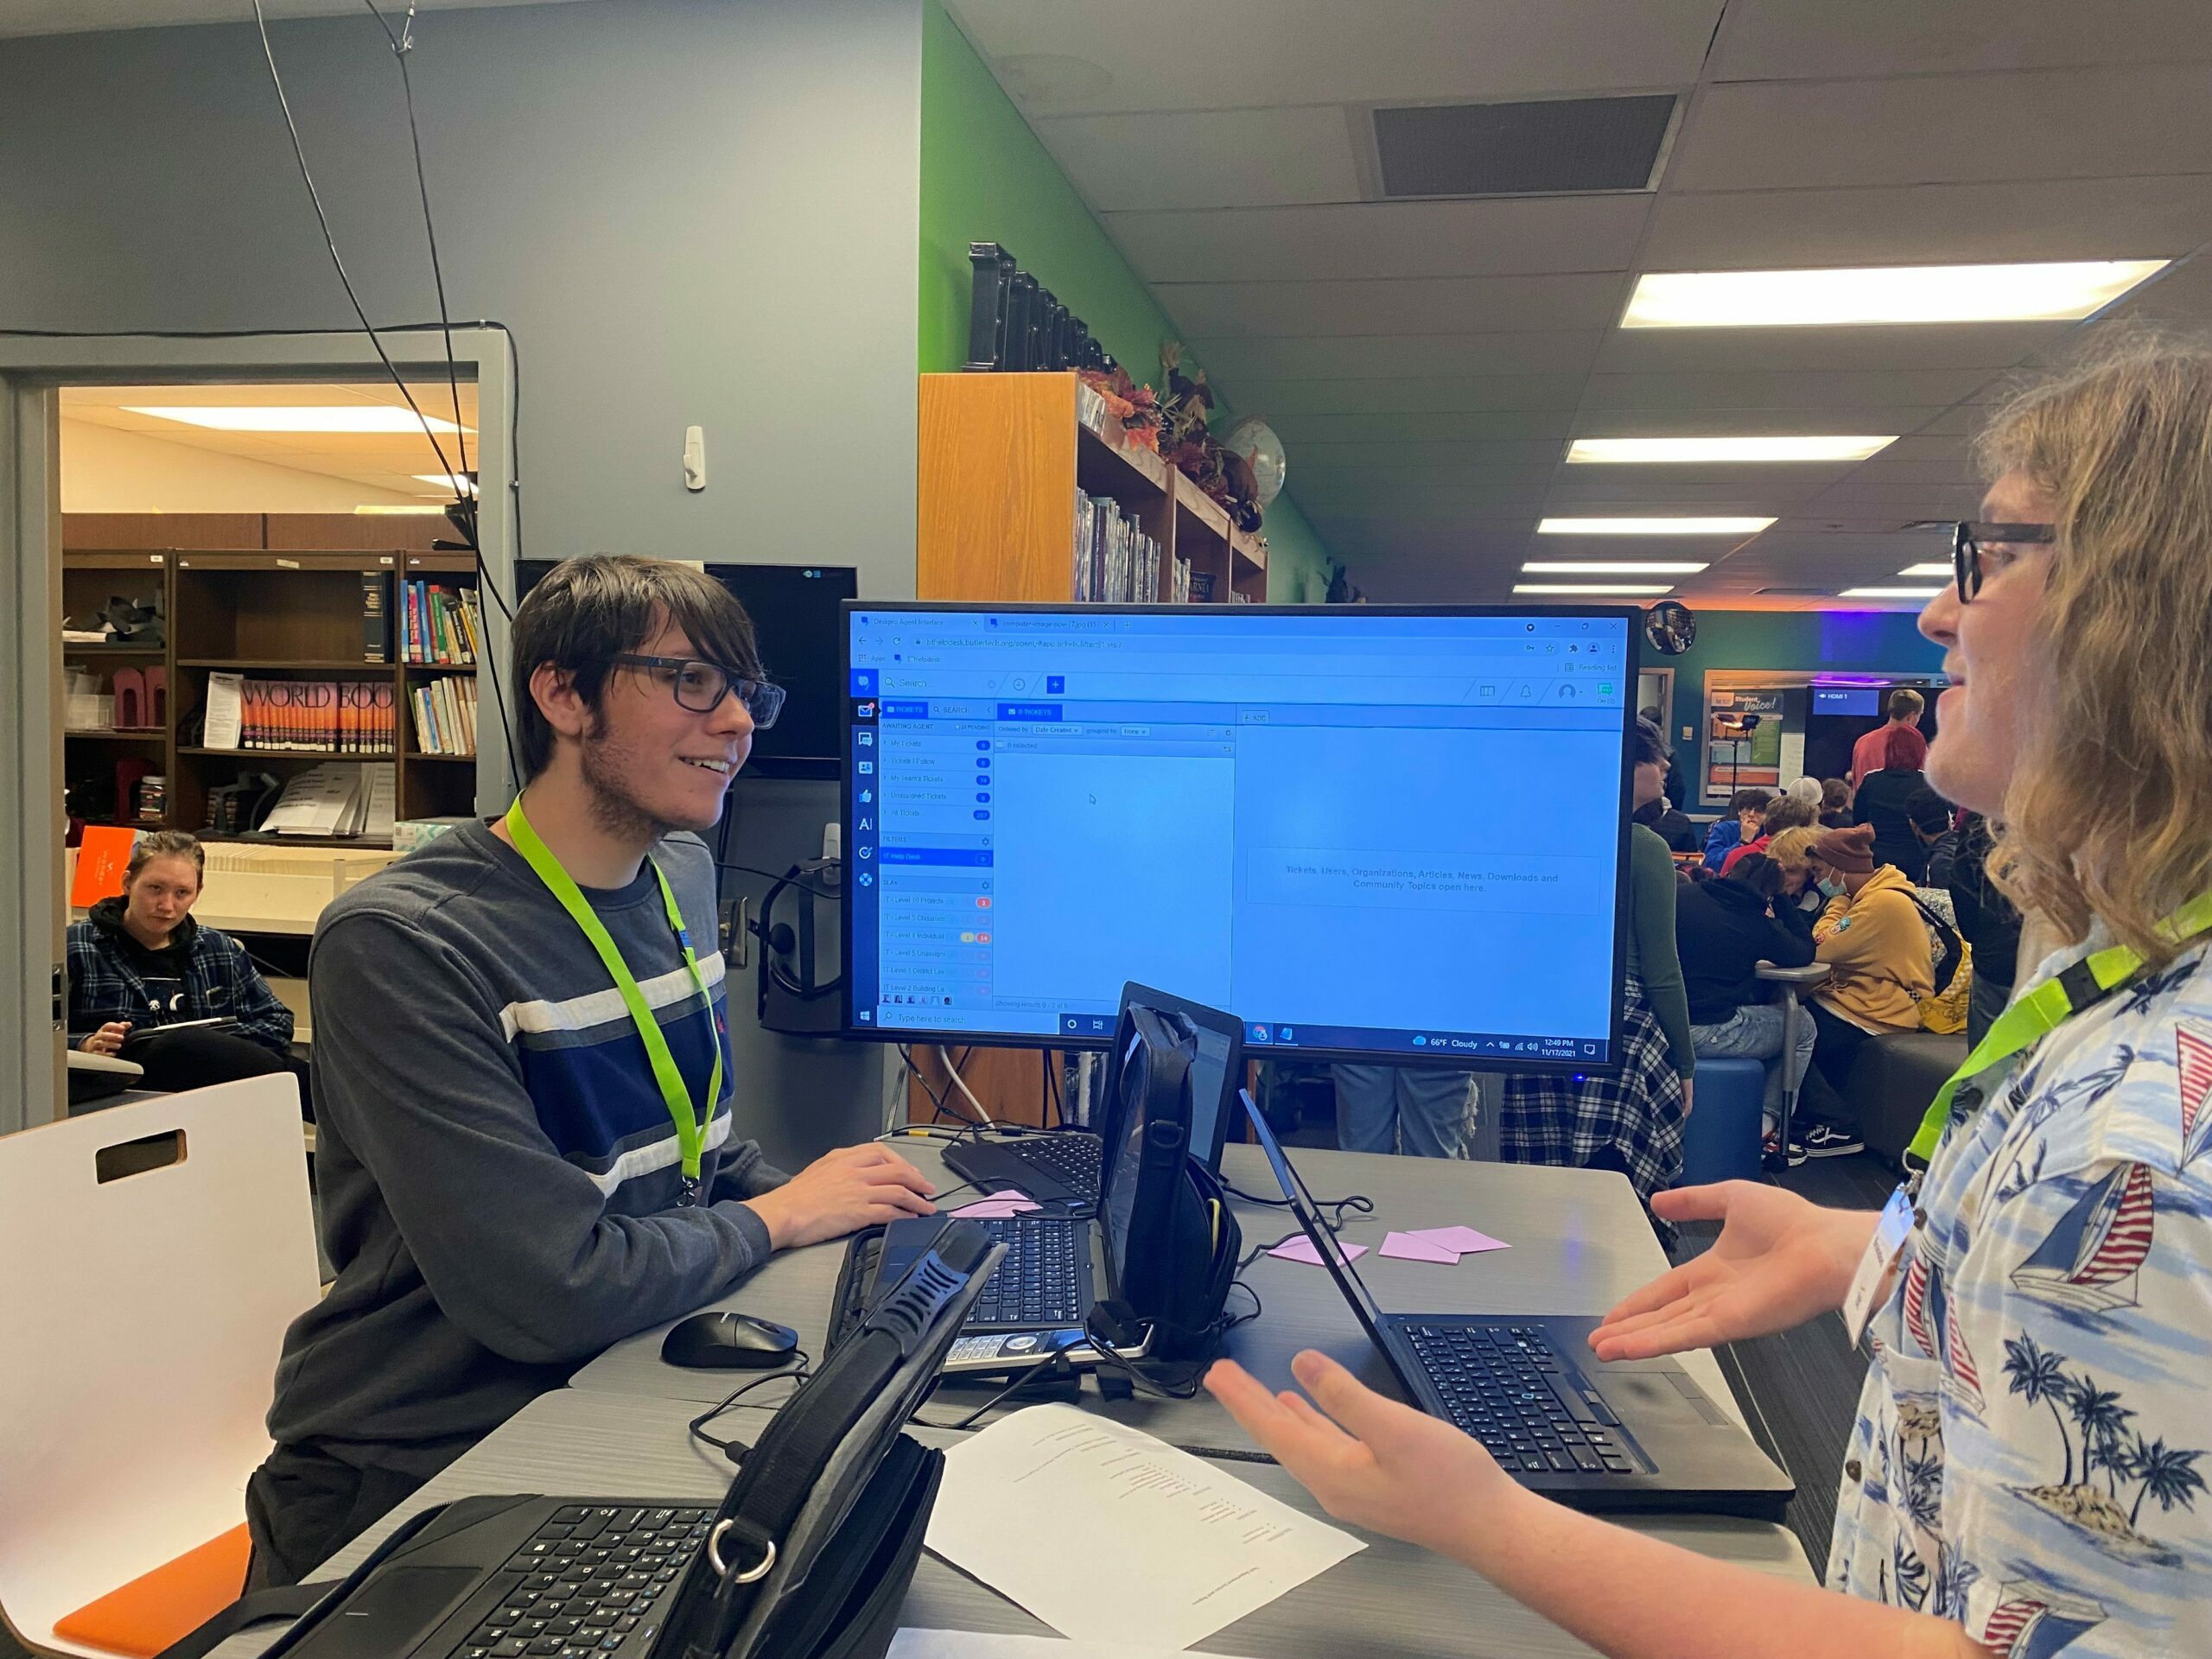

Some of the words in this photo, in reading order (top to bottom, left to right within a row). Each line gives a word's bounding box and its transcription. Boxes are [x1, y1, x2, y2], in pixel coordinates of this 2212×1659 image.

[874, 618, 899, 626] Deskpro
[899, 678, 927, 689] Search
[241, 683, 331, 708] WORLD
[1744, 697, 1777, 711] Voice!
[895, 705, 924, 714] TICKETS
[943, 706, 969, 715] SEARCH
[1351, 868, 1416, 879] Organizations,
[1487, 872, 1538, 882] Downloads
[1541, 874, 1559, 883] and
[1353, 880, 1404, 891] Community
[1408, 881, 1436, 892] Topics
[1438, 883, 1461, 893] open
[1463, 883, 1487, 893] here.
[899, 1014, 915, 1023] Type
[1451, 1039, 1478, 1049] Cloudy
[1541, 1048, 1576, 1058] 11/17/2021
